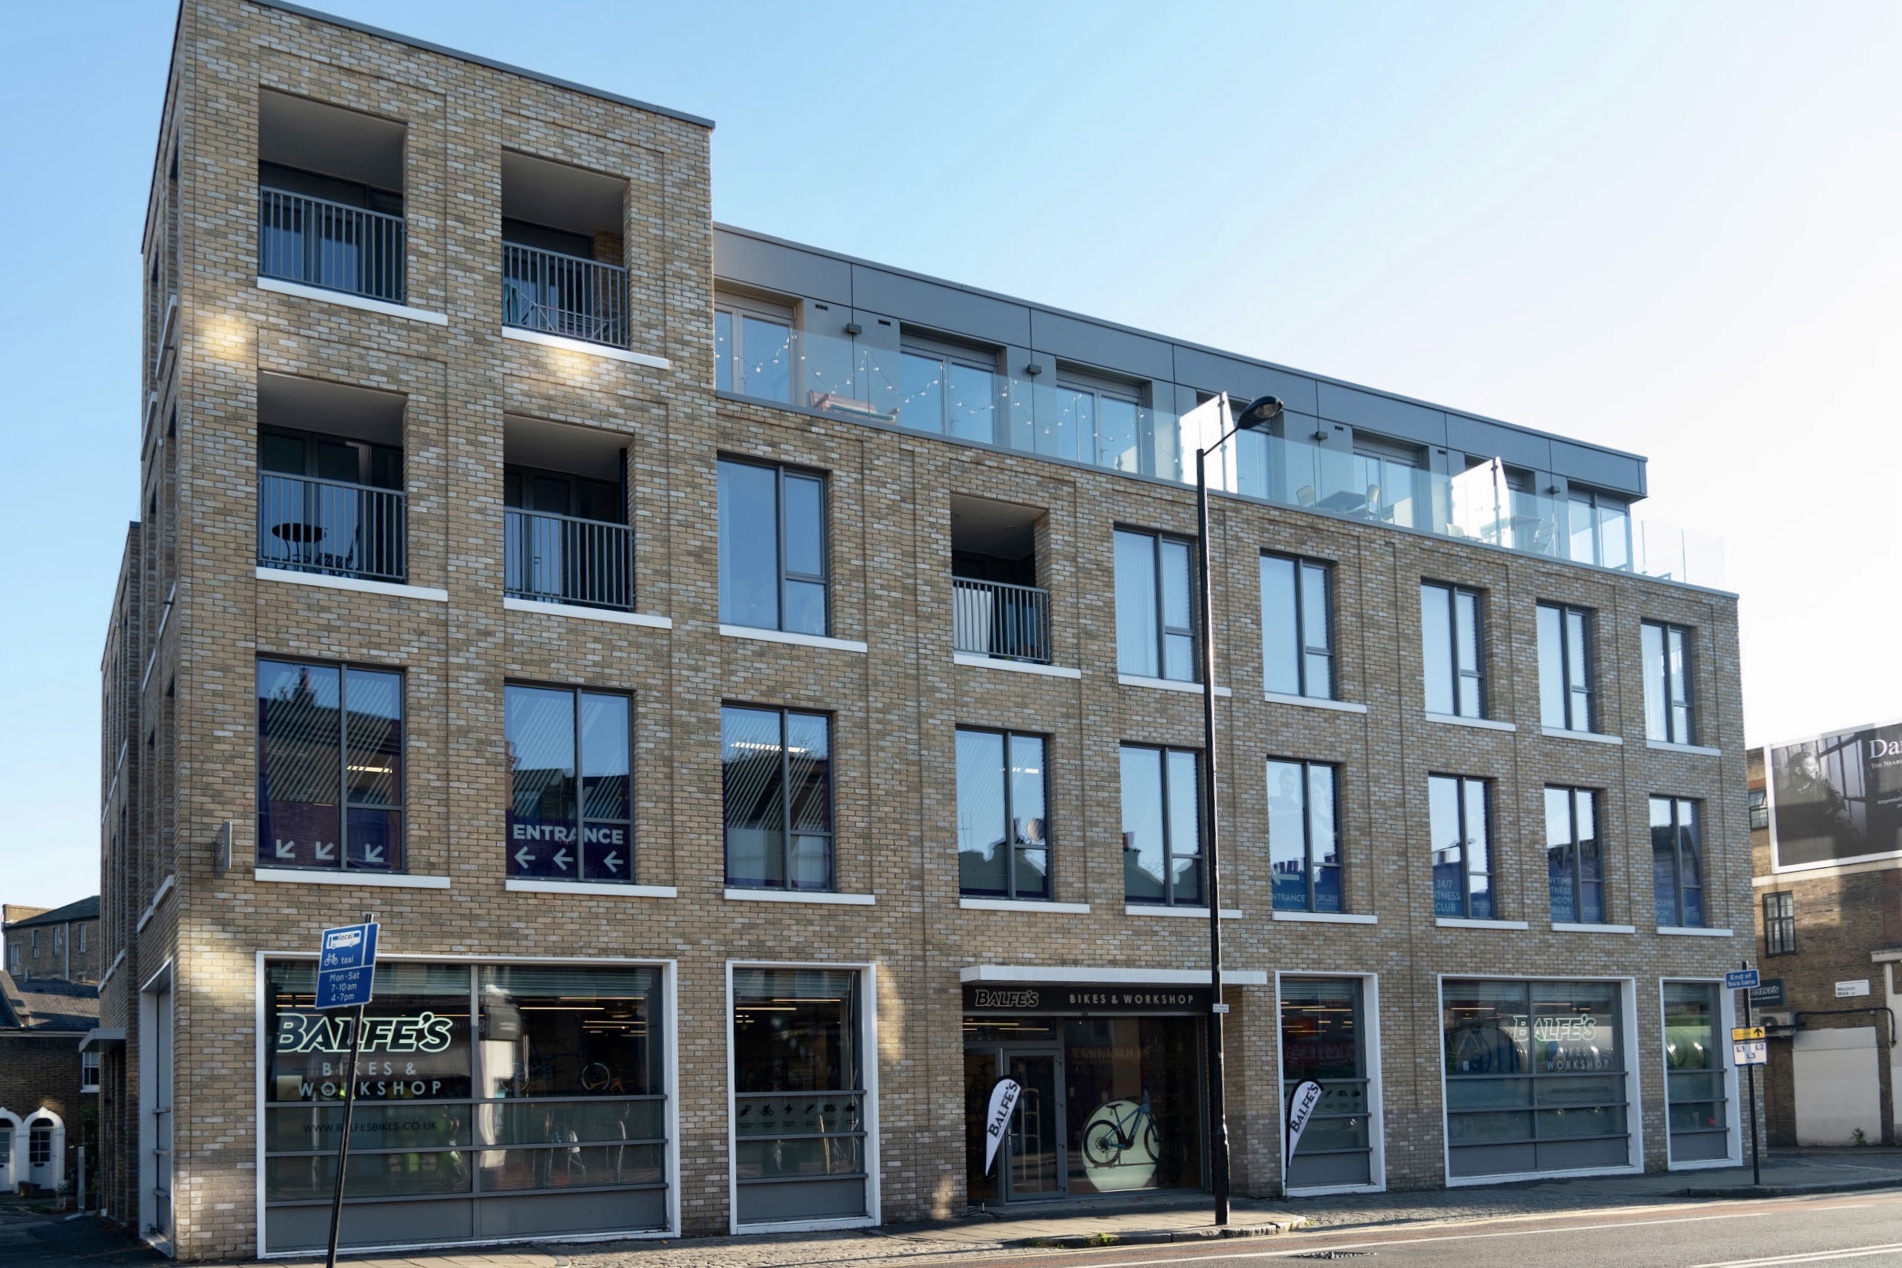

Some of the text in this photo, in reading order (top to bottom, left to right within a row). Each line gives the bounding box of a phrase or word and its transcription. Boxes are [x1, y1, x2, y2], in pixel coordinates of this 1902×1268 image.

[513, 824, 624, 845] ENTRANCE
[1273, 892, 1306, 903] NTRANCE
[1434, 891, 1461, 901] ITNESS
[338, 933, 354, 941] local
[341, 955, 354, 965] taxi
[975, 989, 1194, 1007] BALFE'S BIKES & WORKSHOP
[276, 1011, 453, 1053] BALFE'S
[1512, 1013, 1597, 1042] BALFE'S
[405, 1061, 417, 1075] &
[298, 1080, 442, 1097] WOKSHOP
[987, 1082, 1018, 1138] BALFE'S
[1289, 1083, 1319, 1134] BALFE'S
[303, 1121, 438, 1133] WWW.BLFESBIKES.CO.UK
